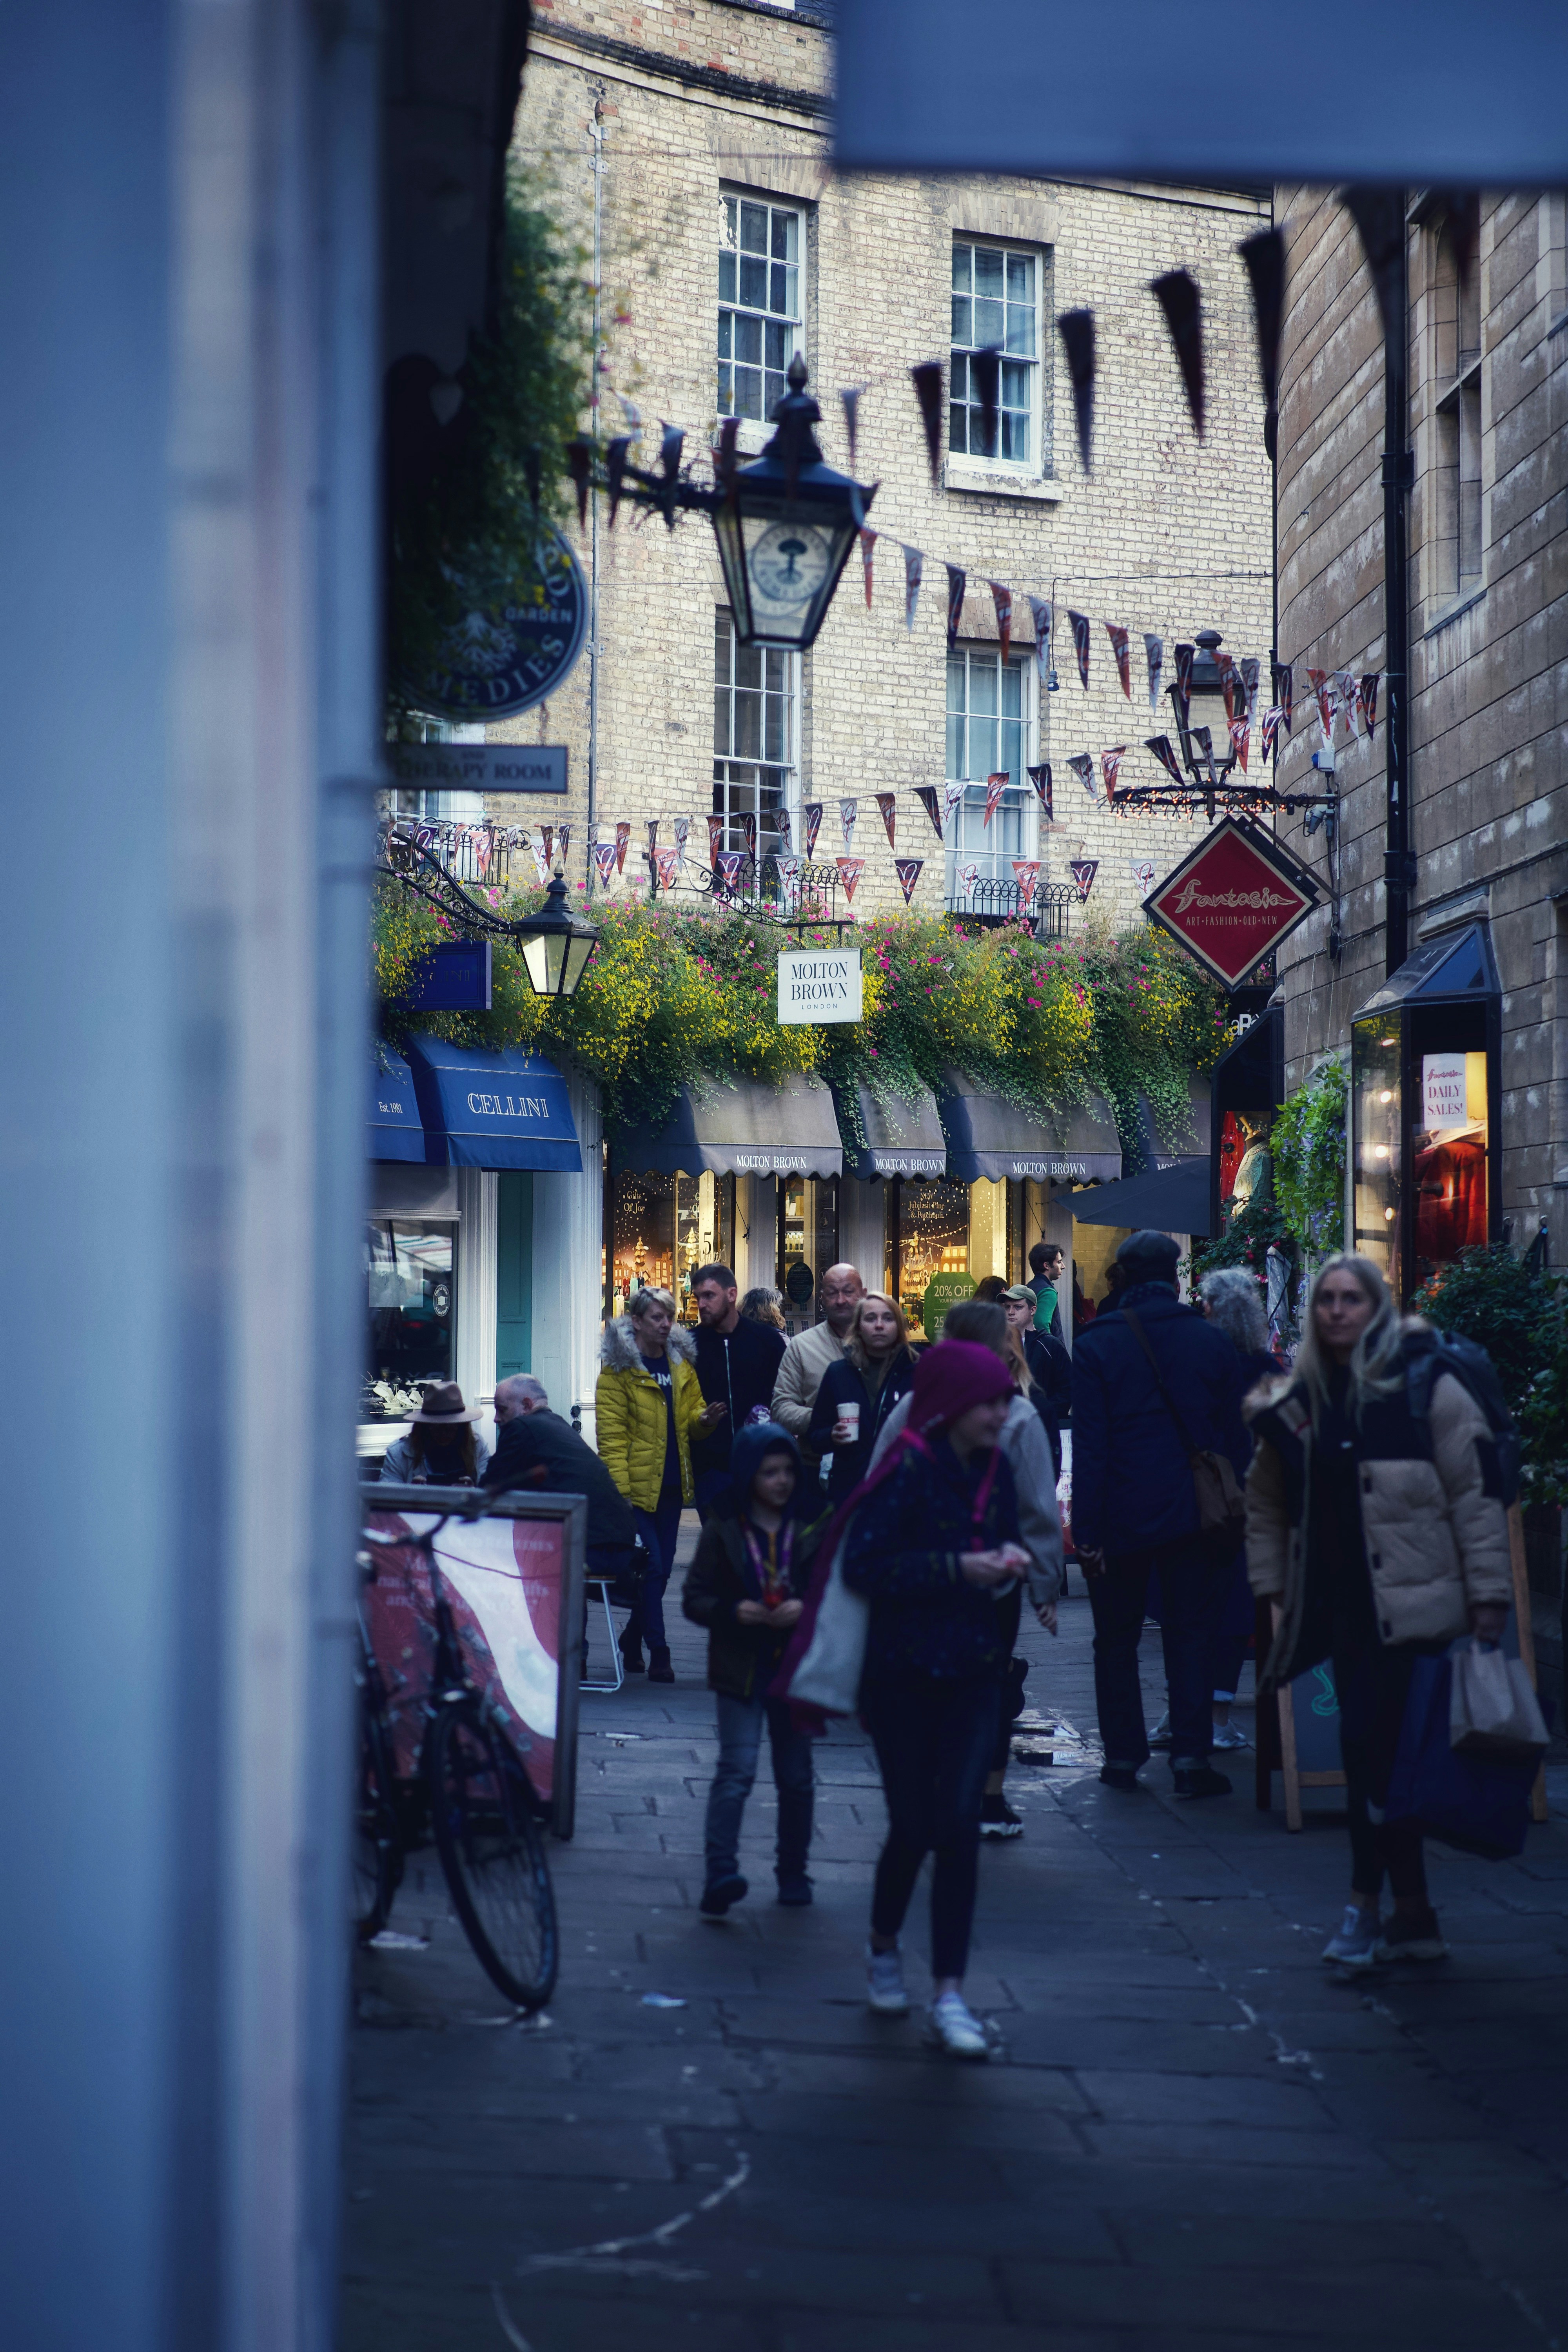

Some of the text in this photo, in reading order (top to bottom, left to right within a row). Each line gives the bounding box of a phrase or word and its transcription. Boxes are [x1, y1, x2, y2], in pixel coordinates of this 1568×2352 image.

[1103, 753, 1123, 765] CAMBRIDGE
[494, 762, 551, 780] ROOM
[989, 780, 1007, 791] CAMBRIDGE
[1172, 879, 1298, 913] fantasia
[1186, 915, 1278, 926] ART FASHION OLD NEW
[791, 962, 848, 980] MOLTON
[791, 982, 848, 1000] BROWN
[1429, 1085, 1462, 1098] DAILY
[378, 1102, 403, 1113] Est. 1981
[467, 1093, 550, 1118] CELLINI
[1427, 1103, 1463, 1115] SALES!
[736, 1155, 807, 1169] MOLTON BROWN
[875, 1158, 944, 1171] MOLTON BROWN
[1013, 1162, 1086, 1174] MOLTON BROWN
[627, 1191, 642, 1200] Gifts
[624, 1203, 645, 1214] Of Joy
[908, 1201, 931, 1210] Jubilant
[934, 1285, 973, 1297] 20% OFF
